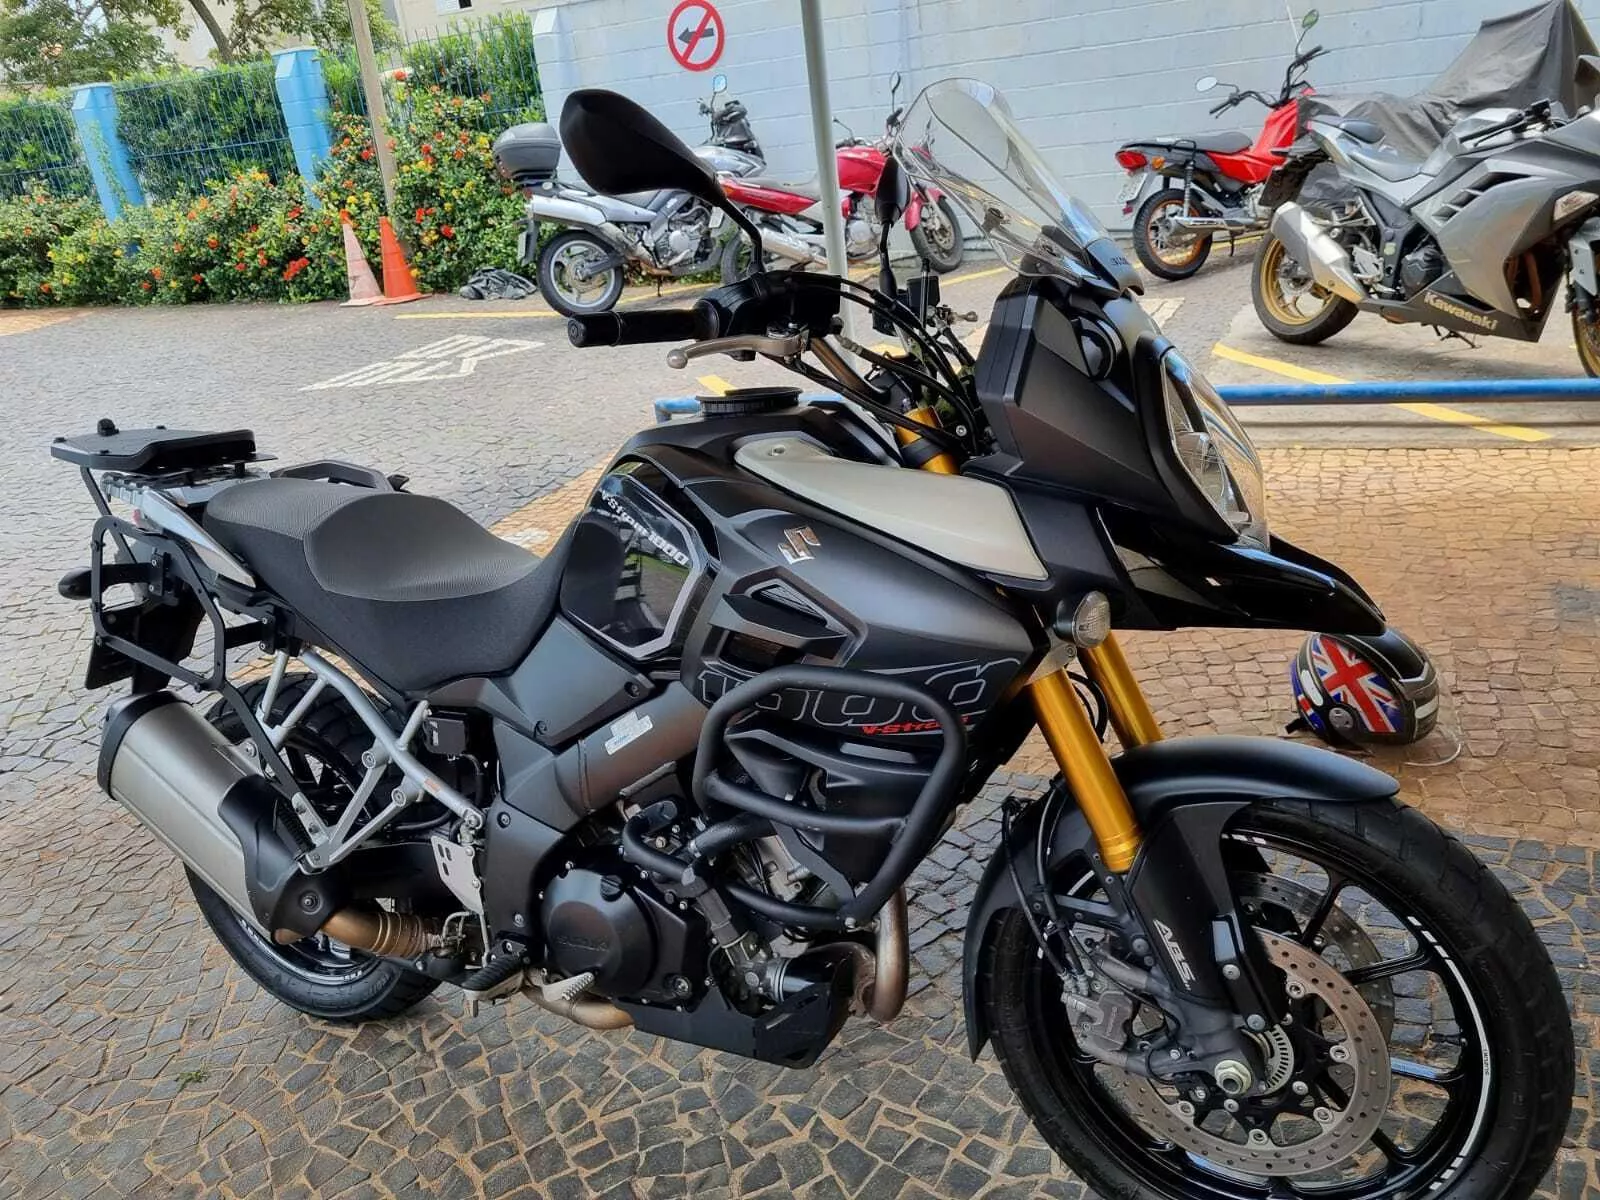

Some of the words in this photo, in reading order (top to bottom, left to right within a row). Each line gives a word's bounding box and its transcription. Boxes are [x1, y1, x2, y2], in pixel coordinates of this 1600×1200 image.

[1423, 291, 1499, 330] Kawasaki
[860, 714, 971, 736] V-Stro
[1152, 918, 1197, 984] ABS
